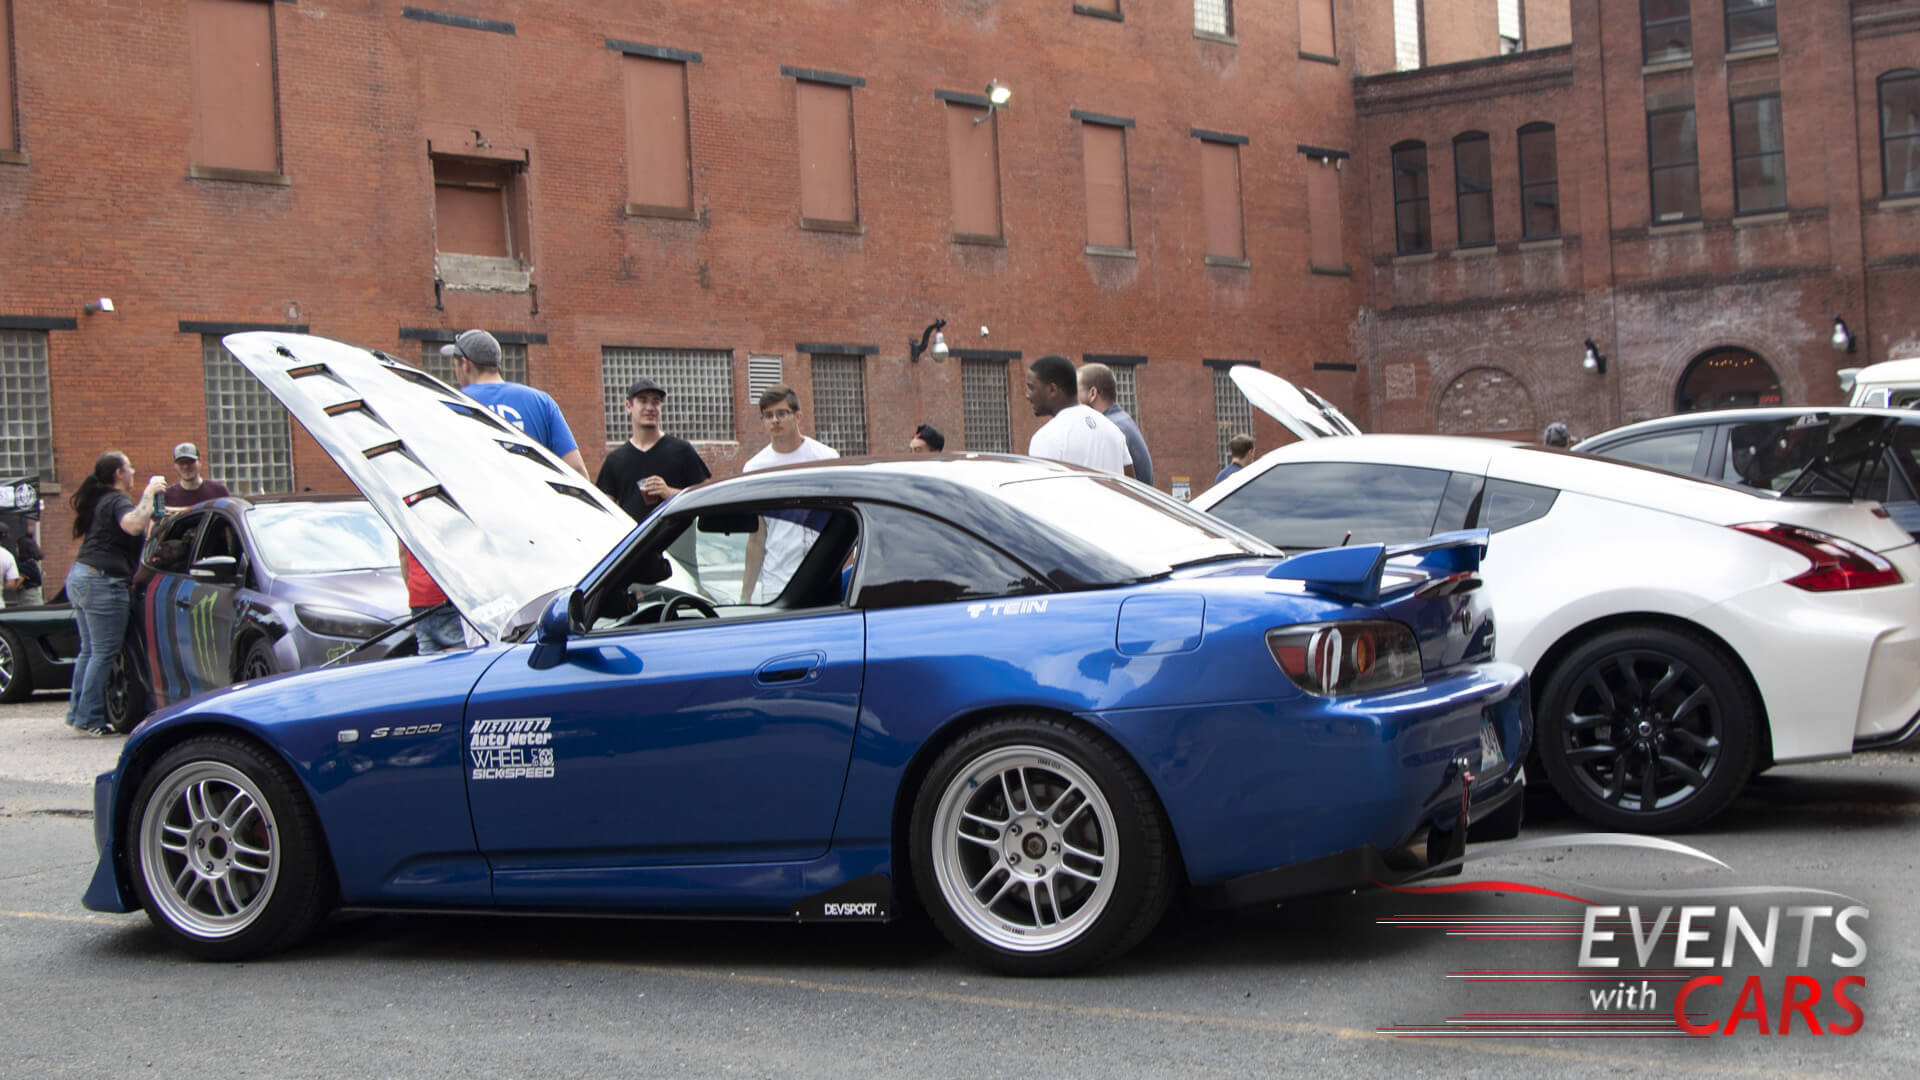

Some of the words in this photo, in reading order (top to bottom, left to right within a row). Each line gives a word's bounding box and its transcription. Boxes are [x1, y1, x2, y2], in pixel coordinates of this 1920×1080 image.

[989, 600, 1048, 616] TEIN
[470, 733, 505, 746] Auto
[471, 748, 532, 768] WHEEL
[824, 903, 877, 916] DEVSPORT
